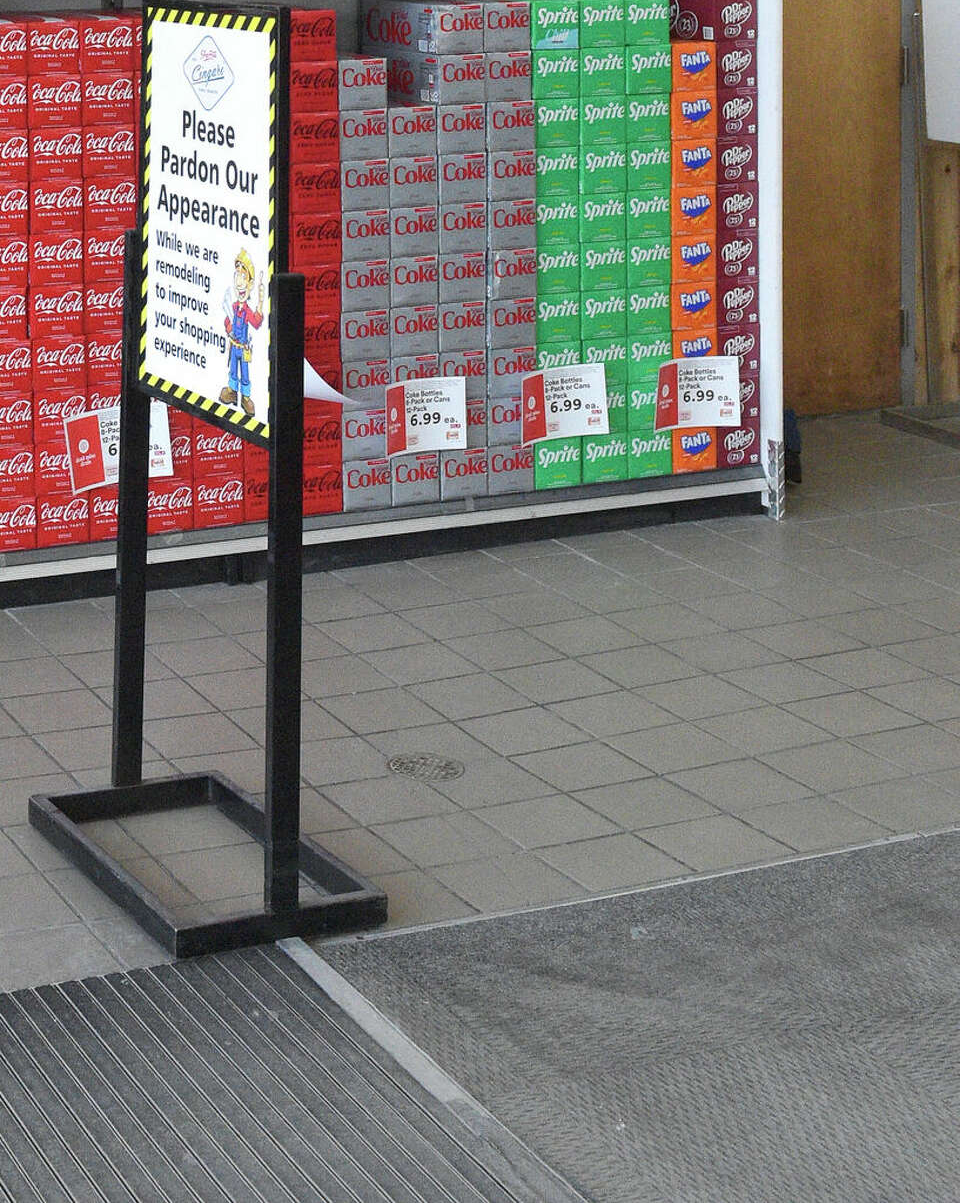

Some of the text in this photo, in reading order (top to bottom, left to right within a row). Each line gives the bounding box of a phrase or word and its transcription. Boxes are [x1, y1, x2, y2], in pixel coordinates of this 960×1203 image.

[440, 11, 483, 33] Coke
[487, 9, 529, 30] Coke
[538, 6, 579, 28] Sprite
[583, 4, 624, 26] Sprite
[627, 0, 668, 24] Sprite
[538, 55, 578, 76] Sprite
[632, 51, 671, 73] Sprite
[680, 50, 711, 68] FANTA
[342, 66, 386, 88] Coke
[584, 102, 625, 124] Sprite
[629, 99, 668, 121] Sprite
[681, 98, 712, 116] FANTA
[182, 109, 236, 148] Please
[392, 113, 436, 136] Coke
[441, 112, 485, 133] Coke
[492, 108, 535, 130] Coke
[586, 151, 626, 172] Sprite
[682, 146, 712, 164] FANTA
[161, 145, 258, 195] Pardon Our
[344, 167, 389, 189] Coke
[443, 160, 486, 182] Coke
[157, 183, 260, 239] Appearance
[630, 196, 670, 219] Sprite
[680, 195, 711, 212] FANTA
[156, 228, 219, 265] While we are
[681, 241, 711, 259] FANTA
[539, 250, 579, 272] Sprite
[156, 259, 211, 293] remodeling
[345, 268, 390, 290] Coke
[156, 281, 209, 317] to improve
[585, 296, 626, 319] Sprite
[154, 310, 227, 354] your shopping
[394, 313, 437, 334] Coke
[154, 337, 207, 369] experience
[550, 399, 582, 413] 6.99
[683, 389, 714, 403] 6.99
[100, 421, 118, 429] Coke
[410, 412, 441, 427] 6.99
[100, 427, 120, 435] 8-Pac
[102, 435, 120, 443] 12-Pa
[681, 432, 712, 450] FANTA
[587, 440, 627, 462] Sprite
[631, 435, 671, 457] Sprite
[445, 457, 488, 479] Coke
[491, 451, 534, 474] Coke
[539, 446, 579, 469] Sprite
[347, 467, 391, 489] Coke
[396, 462, 439, 484] Coke
